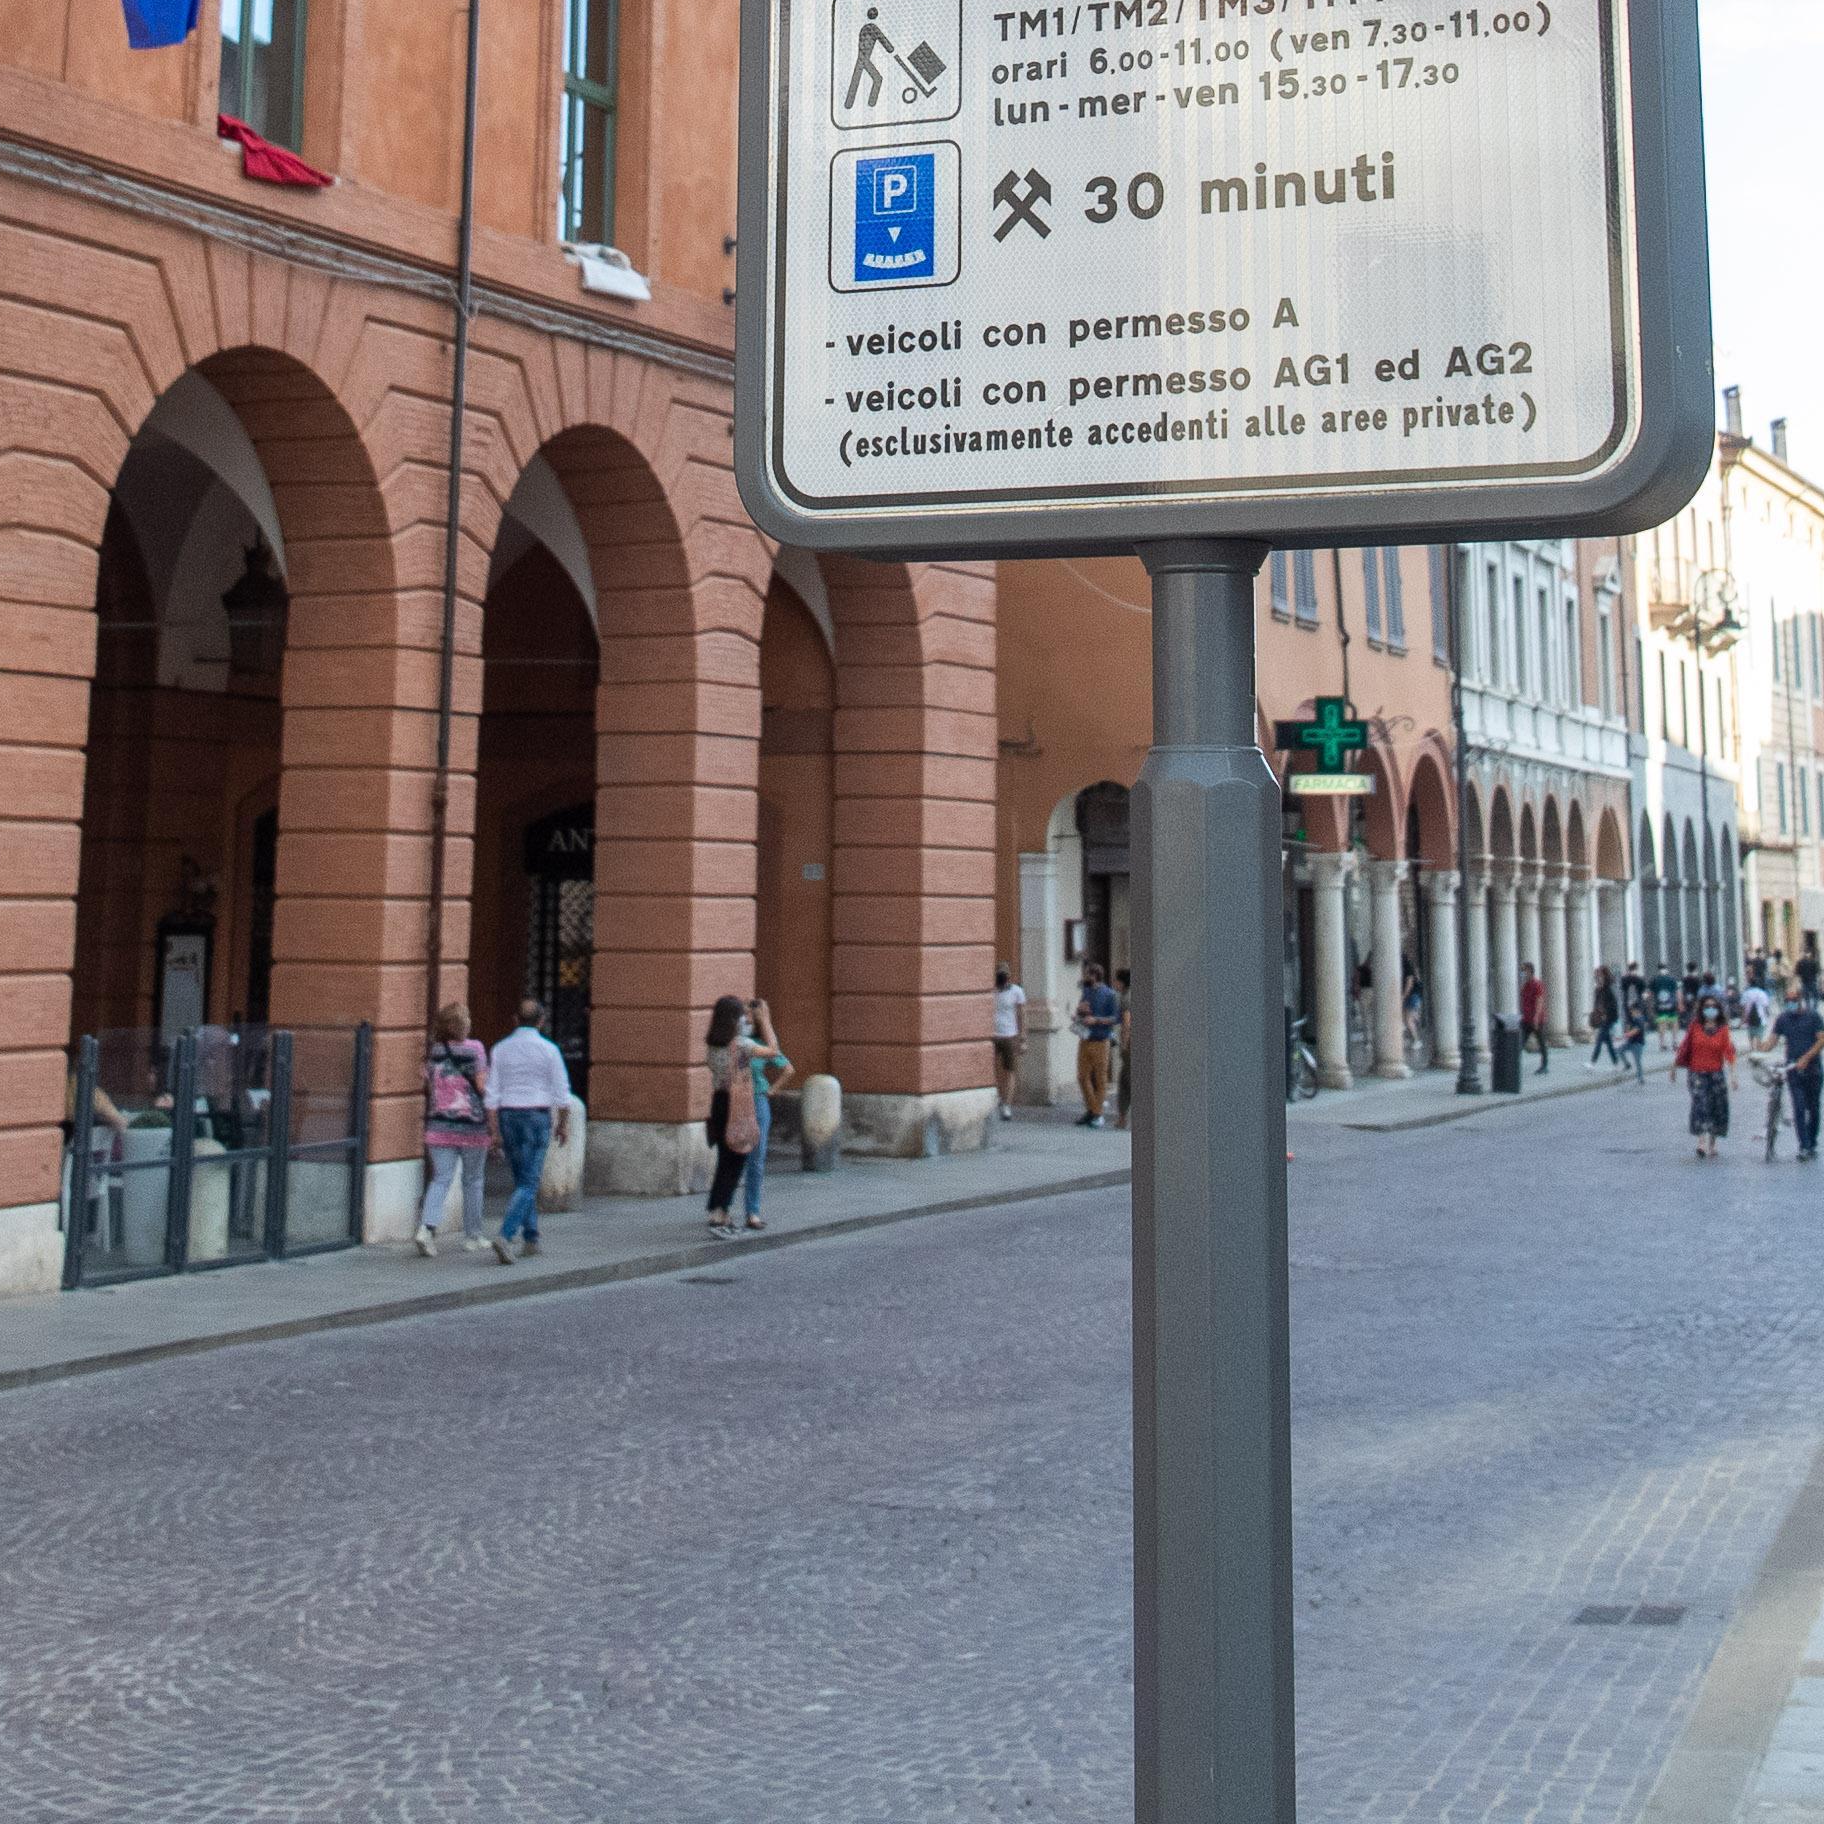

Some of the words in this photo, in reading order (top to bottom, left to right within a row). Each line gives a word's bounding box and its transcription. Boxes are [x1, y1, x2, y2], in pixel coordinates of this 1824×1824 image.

[992, 51, 1068, 85] orari
[883, 174, 906, 208] P
[1084, 171, 1164, 224] 30
[1201, 150, 1395, 215] minuti
[983, 321, 1046, 348] con
[1069, 307, 1250, 348] permesso
[1273, 297, 1299, 328] A
[982, 379, 1046, 406] con
[1069, 366, 1251, 406] permesso
[1273, 352, 1349, 388] AG1
[1375, 349, 1420, 383] ed
[1445, 341, 1533, 378] AG2
[839, 418, 1073, 468] (esclusivamente
[1088, 408, 1227, 447] accedenti
[1245, 405, 1305, 438] alle
[1321, 405, 1387, 434] aree
[1403, 391, 1537, 437] private)
[547, 827, 592, 852] AN
